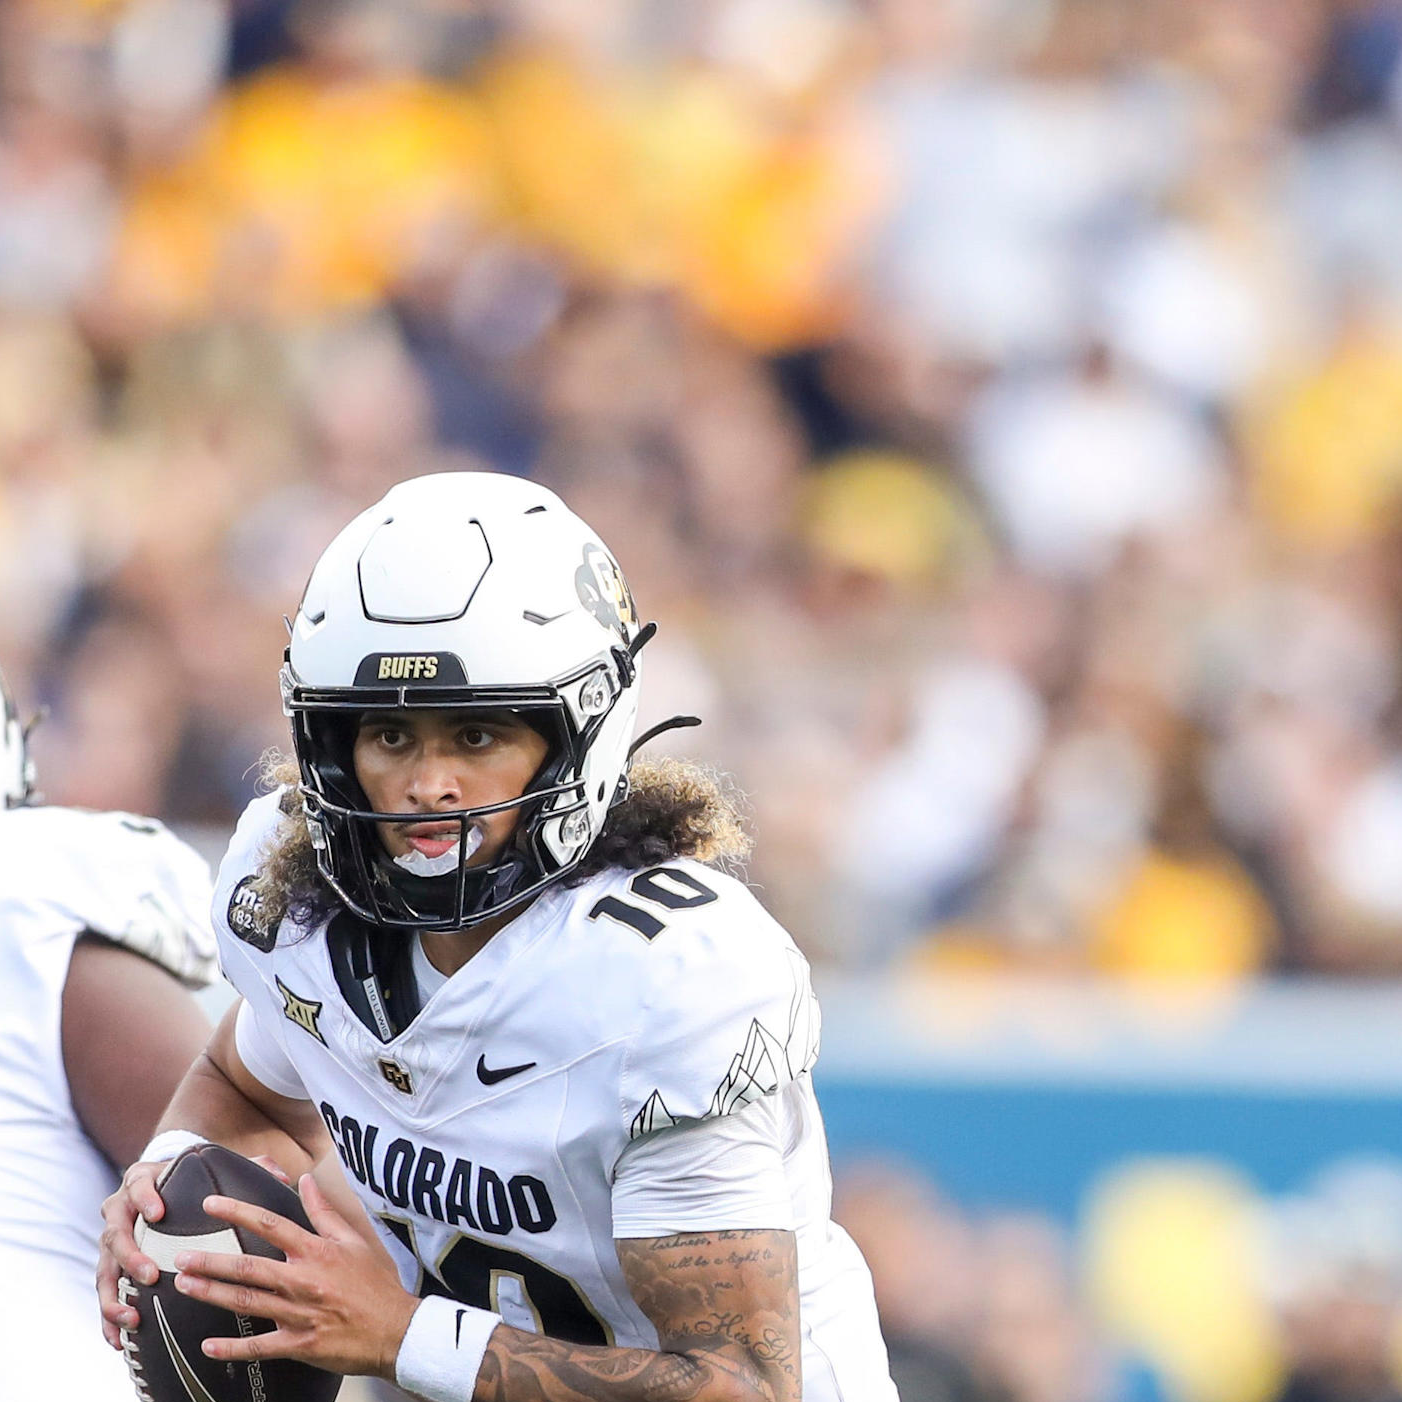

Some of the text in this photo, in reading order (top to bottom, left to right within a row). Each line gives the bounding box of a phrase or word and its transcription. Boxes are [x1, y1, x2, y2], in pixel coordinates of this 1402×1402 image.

[378, 656, 438, 679] BUFFS
[586, 867, 719, 944] 10
[373, 1002, 389, 1037] LEWIS
[320, 1101, 557, 1235] COLORADO
[695, 1312, 750, 1345] His
